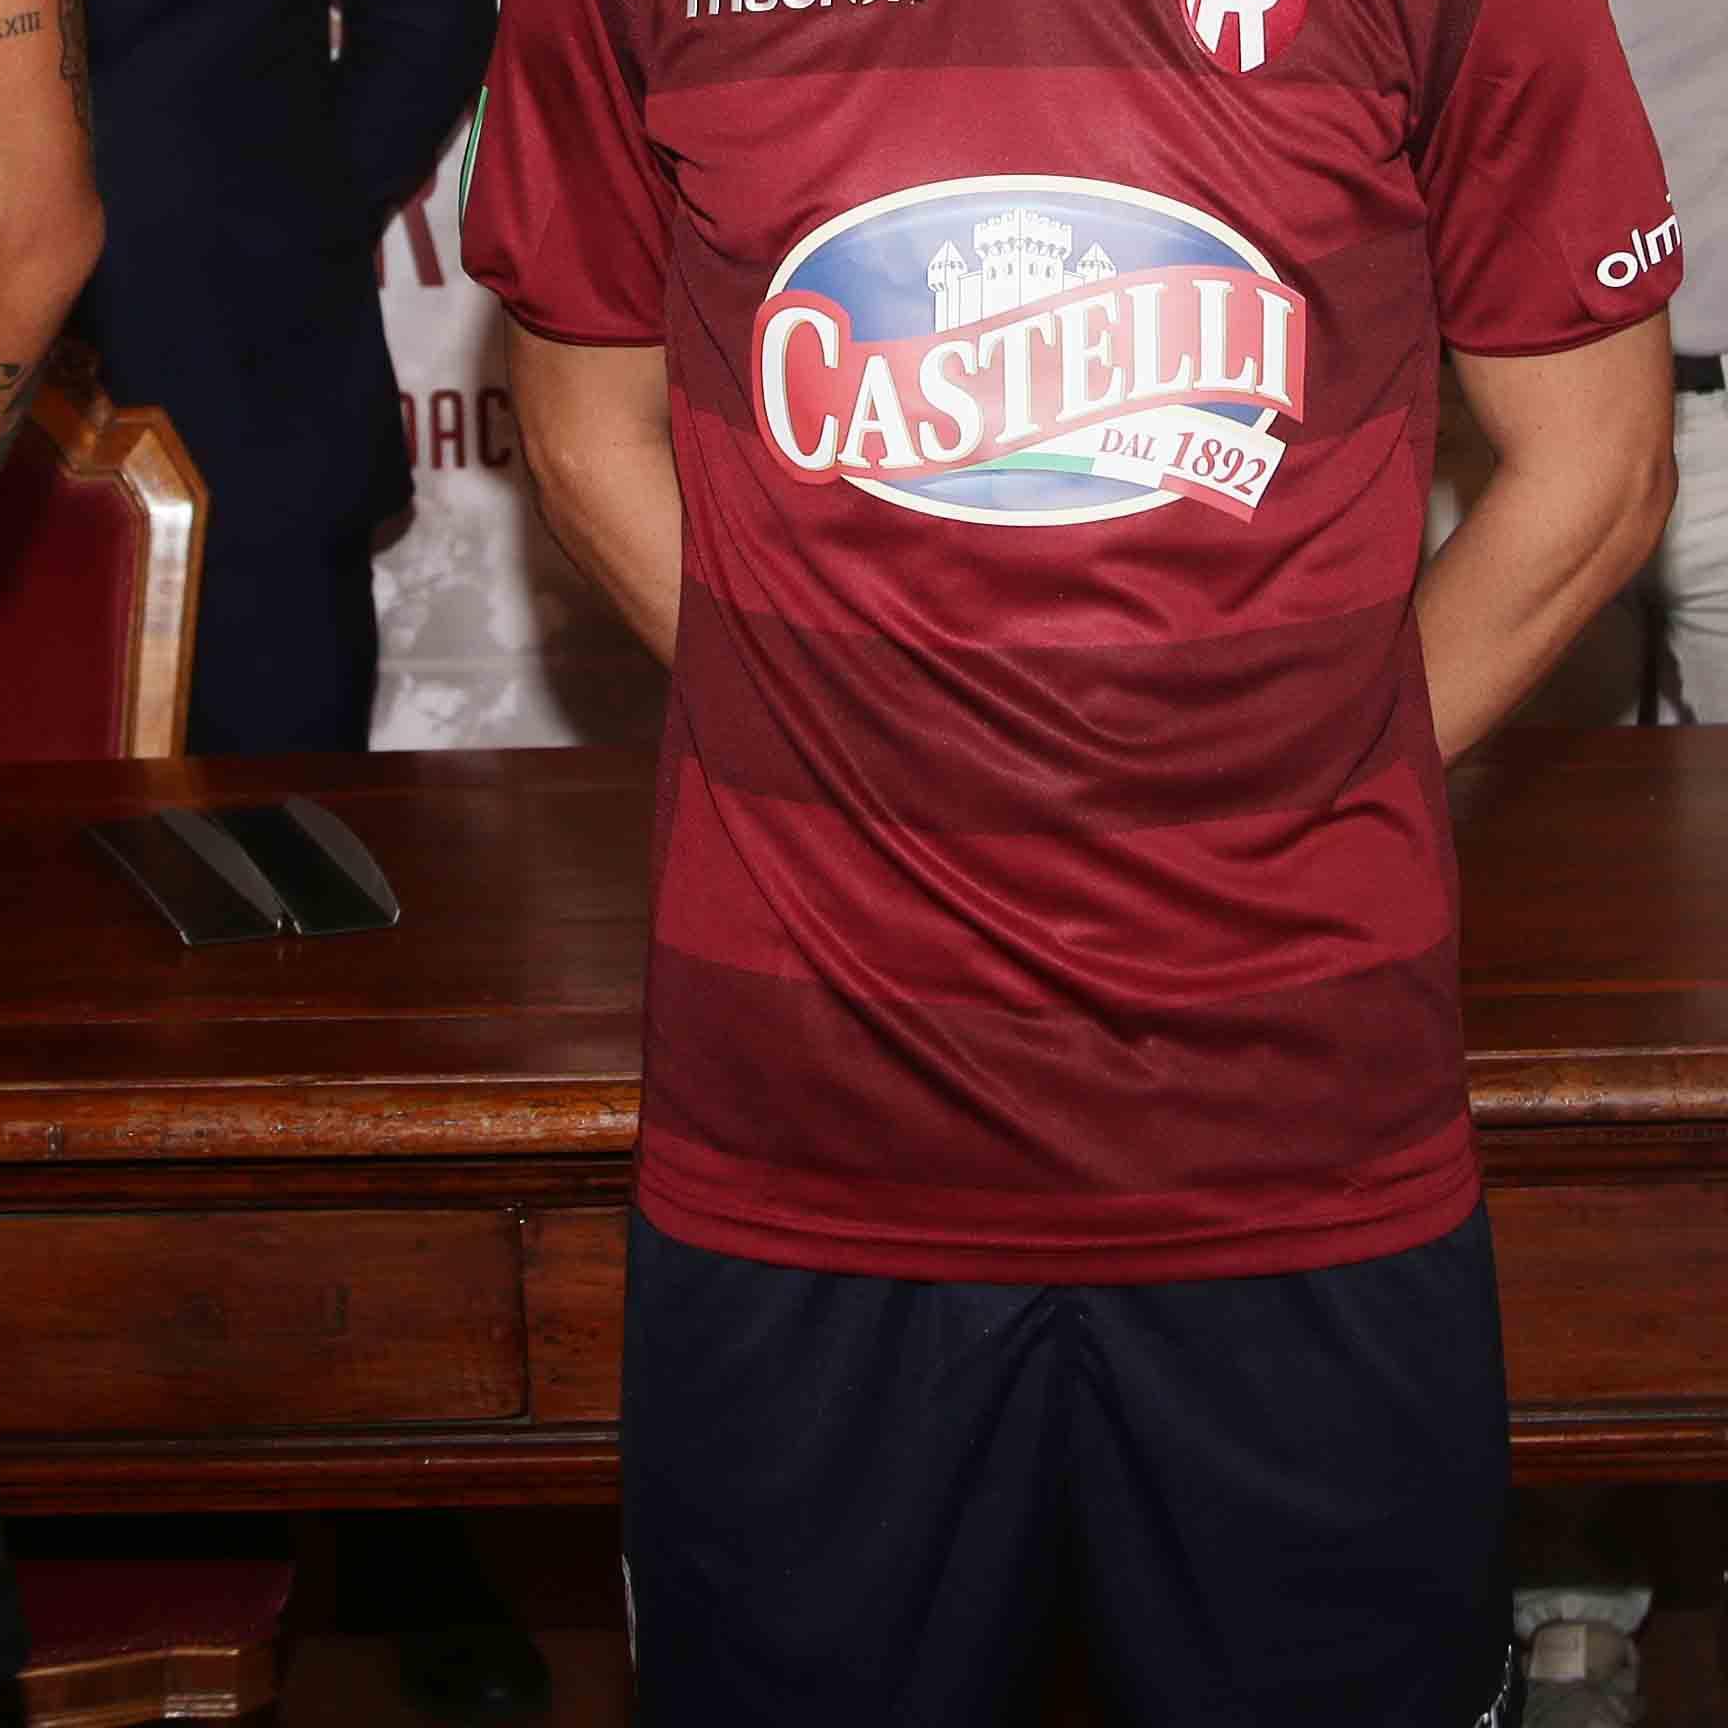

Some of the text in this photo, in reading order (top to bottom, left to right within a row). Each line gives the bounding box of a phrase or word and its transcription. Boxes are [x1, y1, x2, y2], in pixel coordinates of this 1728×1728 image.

[761, 278, 1295, 472] CASTELLI
[1099, 428, 1267, 496] DAL 1892
